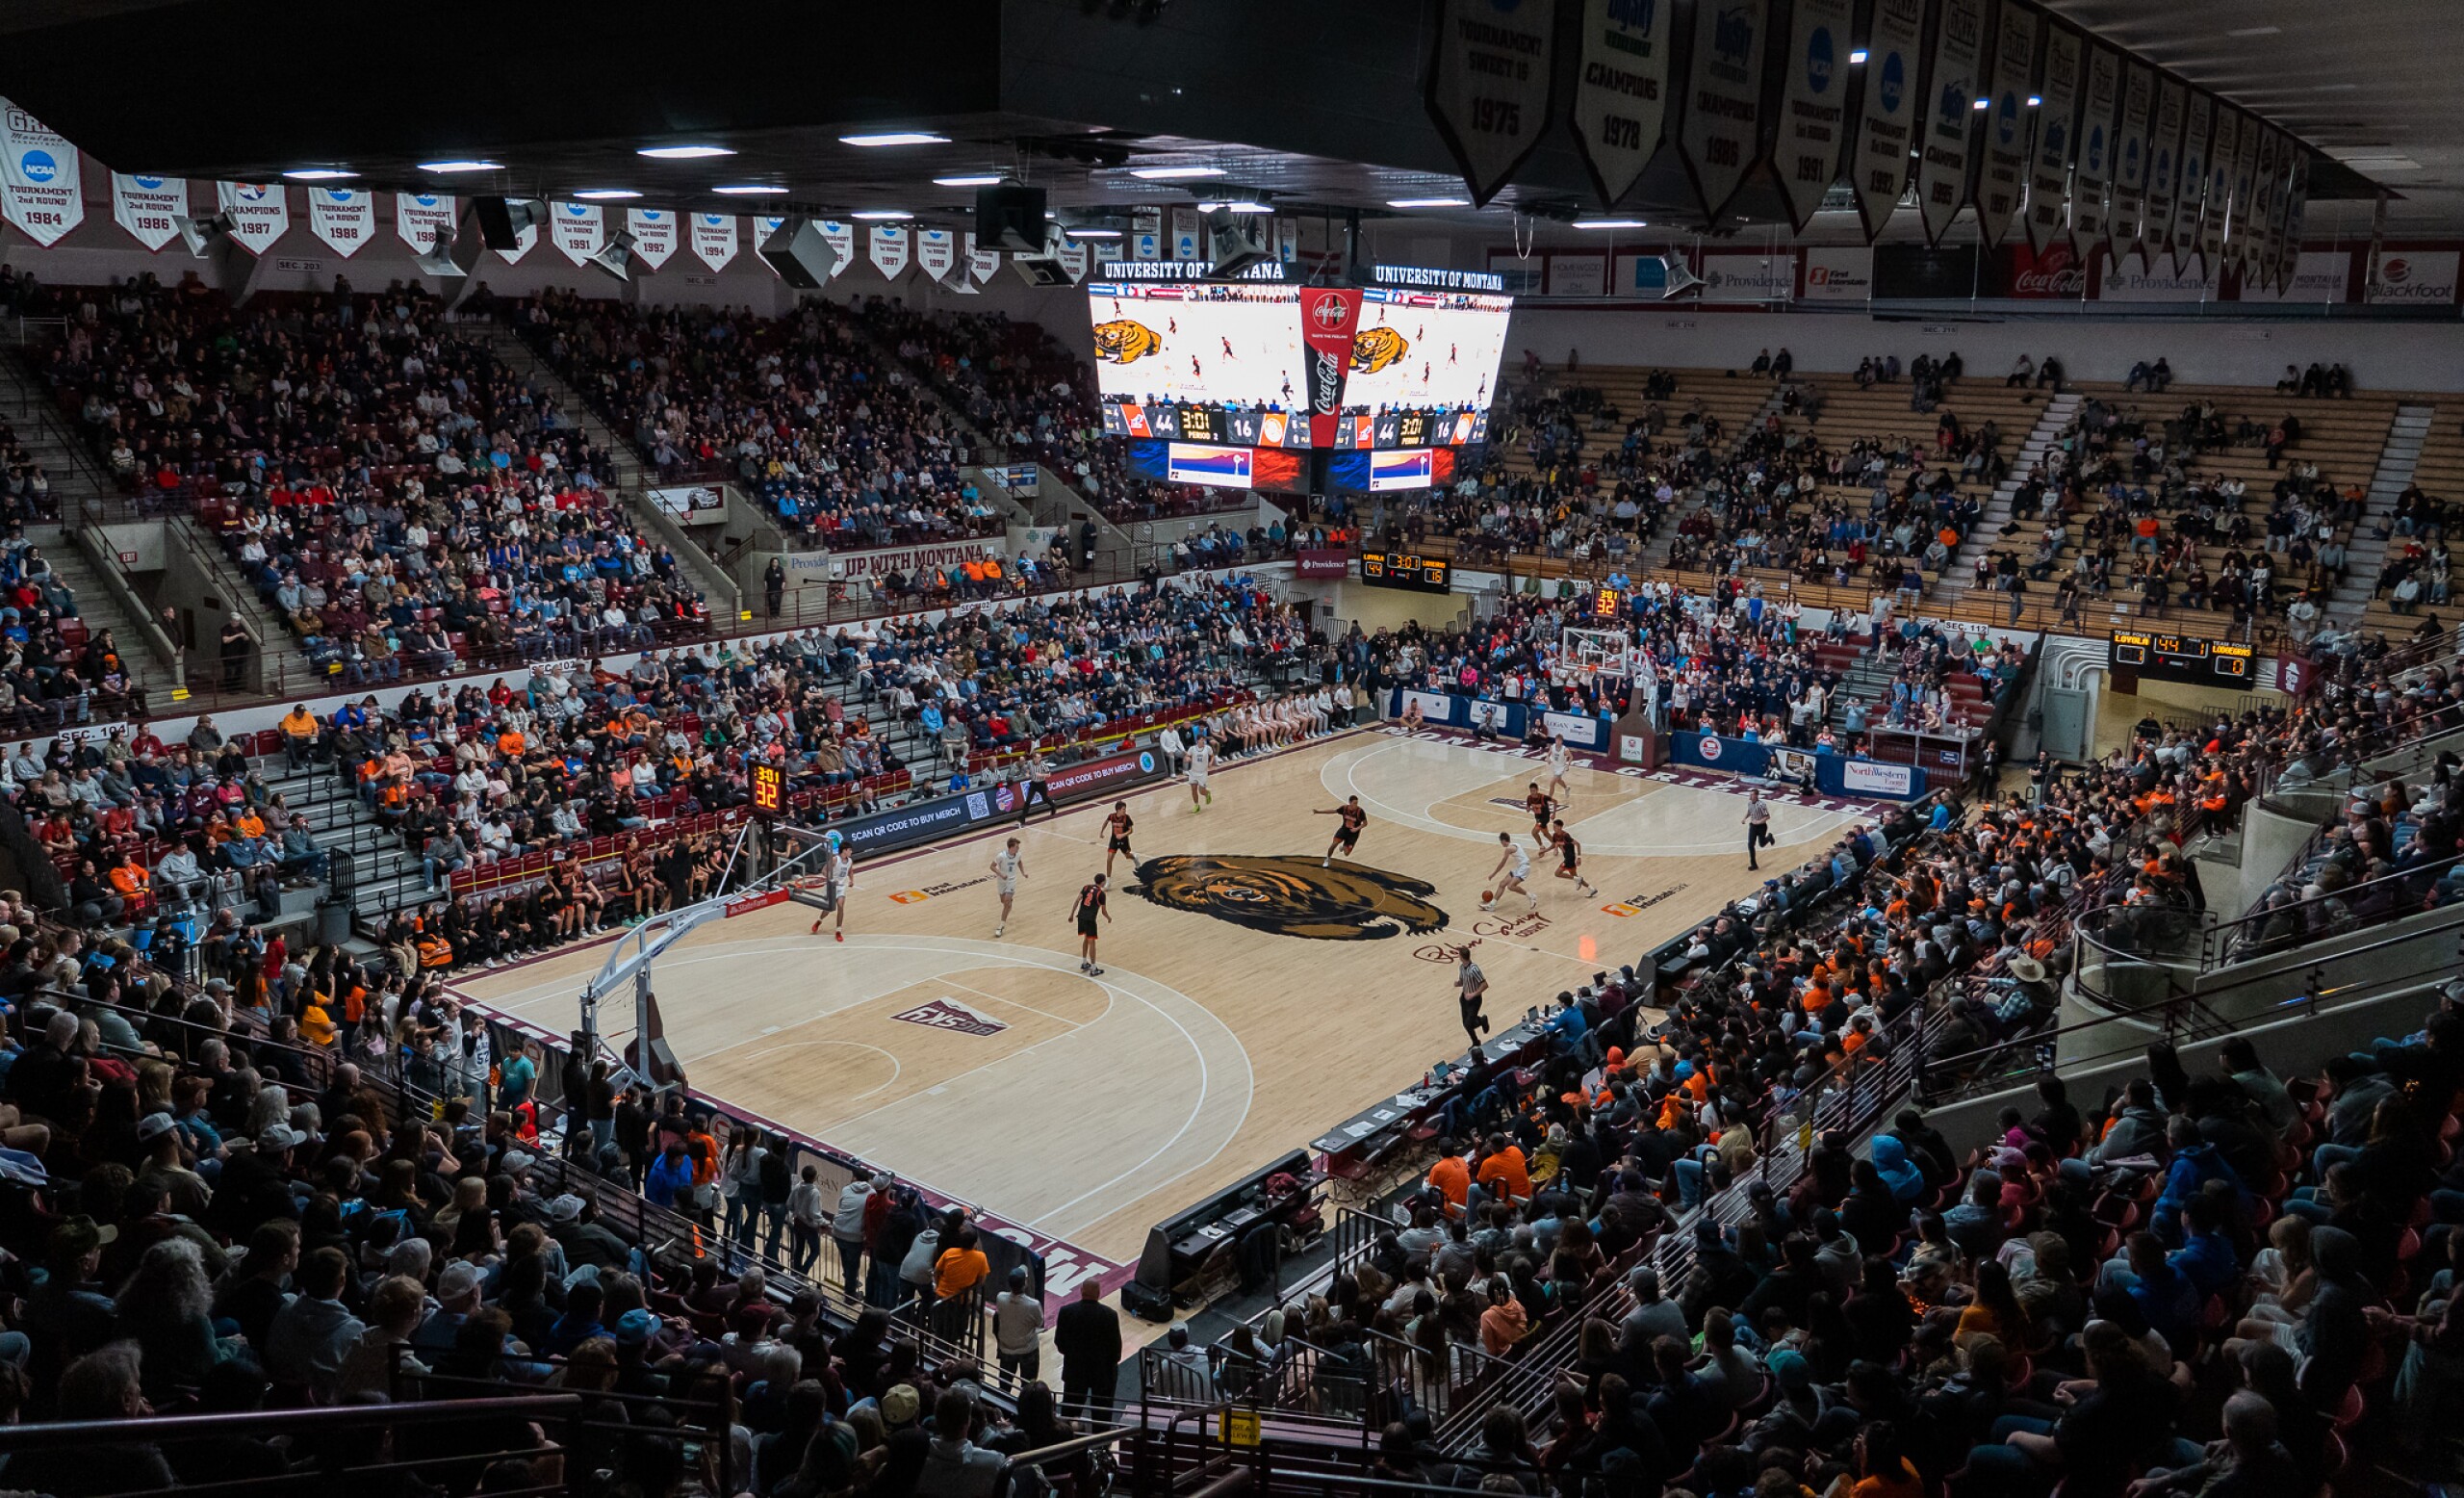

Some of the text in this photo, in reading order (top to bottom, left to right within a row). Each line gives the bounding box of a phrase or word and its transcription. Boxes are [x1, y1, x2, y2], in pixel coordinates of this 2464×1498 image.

[1458, 17, 1542, 56] TOURNAMENT
[1469, 51, 1528, 82] SWEET 16
[1586, 62, 1657, 101] CHAMPIONS
[1697, 90, 1757, 122] CHAMPIONS
[1472, 96, 1520, 137] 1975
[1603, 114, 1641, 150] 1978
[25, 165, 56, 176] NCAA
[1797, 155, 1824, 183] 1991
[9, 184, 74, 196] TOURNAMENT
[120, 191, 181, 203] TOURNAMENT
[17, 195, 68, 206] 2nd ROUND
[129, 202, 175, 213] 2nd ROUND
[315, 203, 368, 214] TOURNAMENT
[402, 208, 451, 218] TOURNAMENT
[25, 211, 64, 225] 1984
[137, 217, 170, 230] 1986
[324, 213, 362, 223] 1st ROUND
[409, 217, 423, 225] 2nd
[556, 217, 599, 227] TOURNAMENT
[242, 222, 271, 235] 1987
[633, 221, 673, 231] TOURNAMENT
[329, 227, 359, 240] 1988
[569, 239, 591, 251] 1991
[643, 242, 665, 254] 1992
[705, 245, 726, 258] 1994
[278, 260, 321, 271] SEC. 203
[882, 256, 899, 267] 1997
[928, 258, 945, 269] 1998
[1106, 262, 1205, 279] UNIVERSITY OF
[1375, 265, 1502, 290] UNIVERSITY OF MONTANA
[1725, 273, 1793, 288] Providence
[2015, 269, 2086, 293] Coca-Cola
[1314, 348, 1339, 416] Coca-Cola
[1156, 414, 1174, 431] 44
[1181, 411, 1210, 429] 3:01
[1400, 418, 1424, 435] 3:01
[1234, 419, 1251, 437] 16
[1380, 423, 1395, 440] 44
[1437, 422, 1450, 439] 16
[1188, 430, 1219, 442] PERIOD 2
[845, 544, 984, 577] UP WITH MONTANA
[1312, 560, 1346, 569] Providence
[1363, 554, 1385, 562] LOYOLA
[1397, 555, 1419, 569] 3:01
[1369, 564, 1382, 575] 44
[1431, 571, 1442, 582] 16
[1601, 590, 1618, 600] 3:01
[1597, 598, 1615, 614] 32
[2114, 634, 2150, 646] LOYOLA
[2158, 639, 2179, 652] 44
[2232, 659, 2244, 674] 0
[1547, 720, 1569, 730] LOGAN
[62, 724, 126, 742] SEC. 104
[758, 765, 780, 784] 3:01
[1047, 762, 1136, 791] SCAN QR CODE TO BUY MERCH
[1849, 763, 1907, 780] NorthWestern
[757, 780, 777, 809] 32
[851, 806, 961, 842] SCAN QR CODE TO BUY MERCH
[921, 882, 953, 894] First
[930, 875, 988, 897] Interstate
[1083, 892, 1093, 907] 2
[1624, 894, 1648, 905] First
[1636, 890, 1676, 910] Interstate
[897, 1006, 967, 1027] SKY
[951, 1020, 997, 1035] BIG
[476, 1050, 489, 1065] 52
